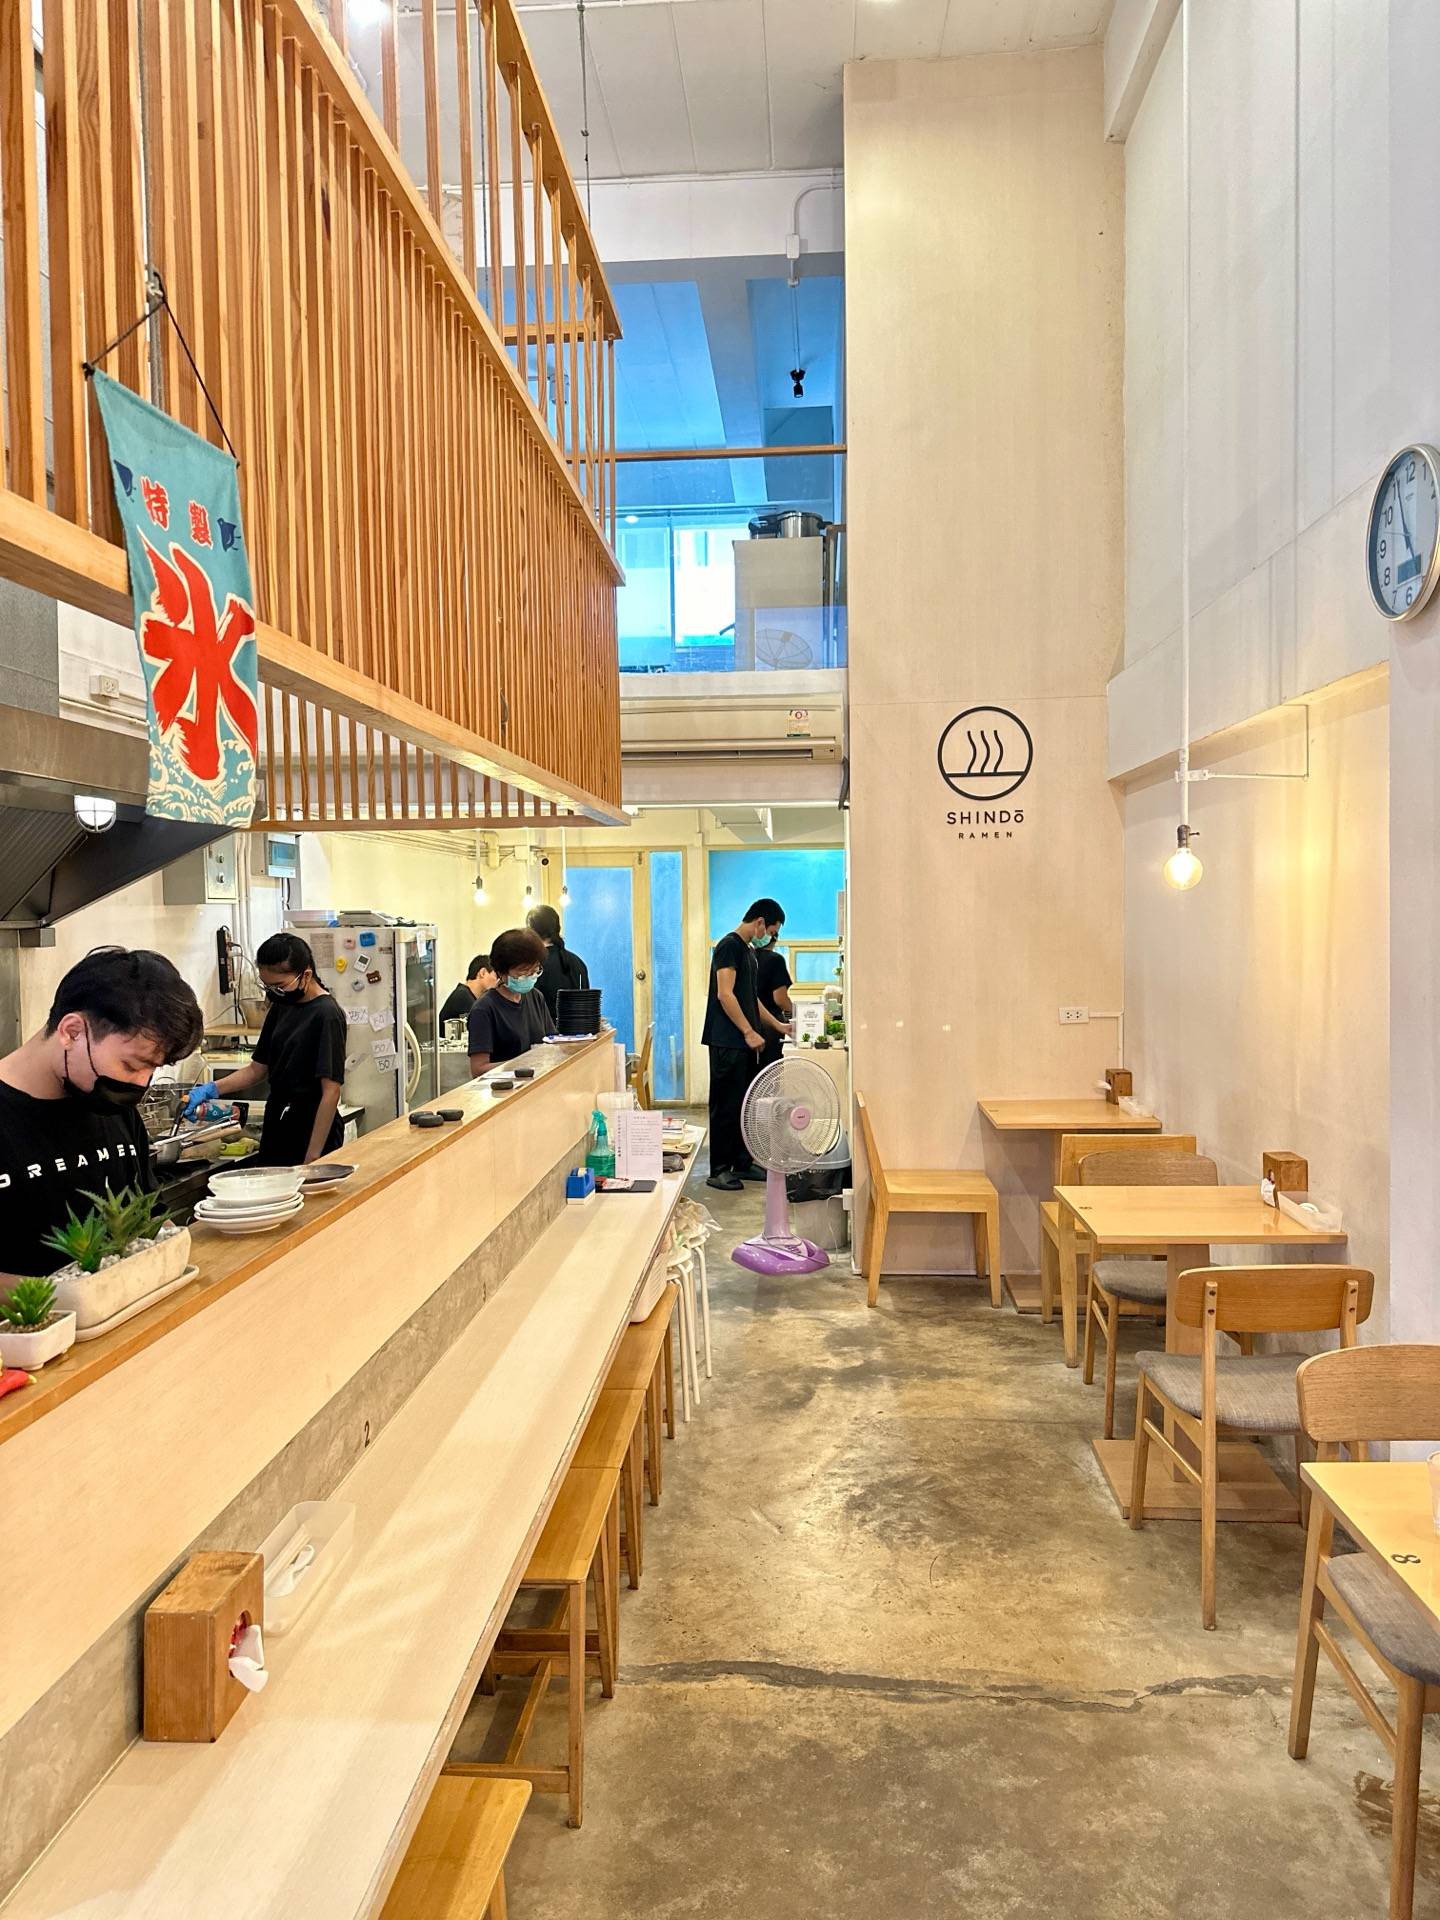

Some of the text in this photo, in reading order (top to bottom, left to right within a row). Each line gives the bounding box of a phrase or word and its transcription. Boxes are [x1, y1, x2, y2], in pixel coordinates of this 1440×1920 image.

[1405, 461, 1416, 485] 12
[141, 476, 214, 549] 特製
[1383, 505, 1393, 528] 10
[1379, 539, 1387, 559] 9
[1383, 567, 1391, 586] 8
[1405, 586, 1413, 606] 6
[141, 528, 258, 782] 氷
[958, 831, 1013, 840] RAMEN
[364, 1420, 370, 1448] 2
[1391, 1554, 1421, 1564] 8
